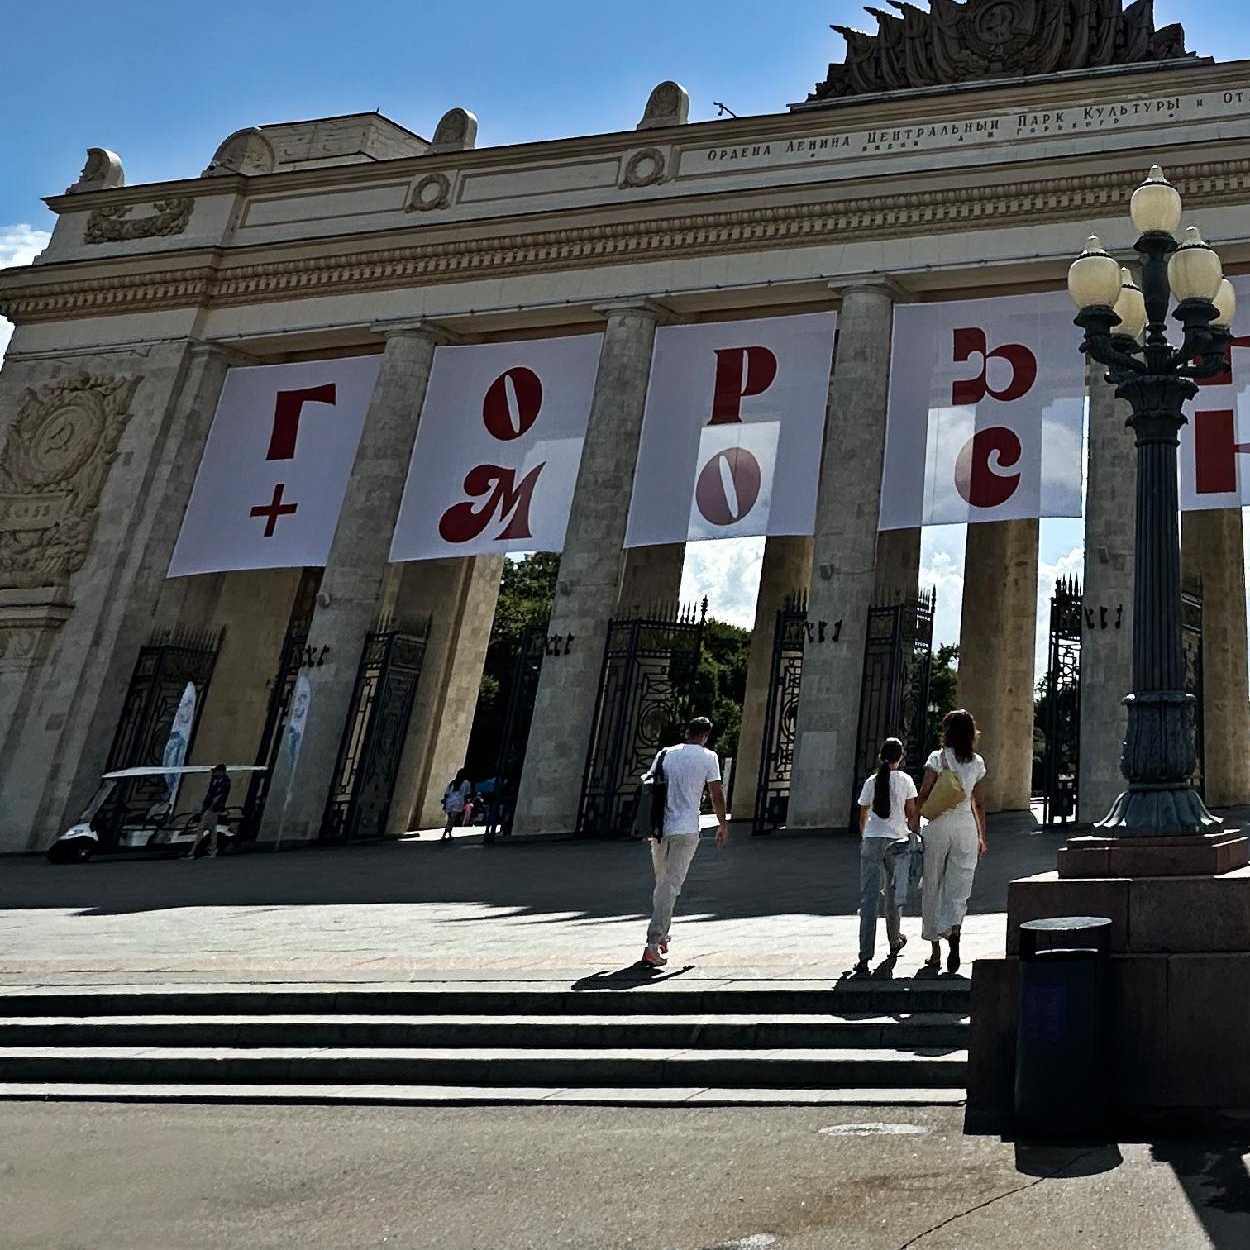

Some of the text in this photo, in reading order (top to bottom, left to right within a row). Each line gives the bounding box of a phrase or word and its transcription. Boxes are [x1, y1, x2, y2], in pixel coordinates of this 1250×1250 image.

[707, 145, 771, 161] ОРДЕНА
[785, 136, 850, 152] ЛЕНИНА
[1018, 112, 1065, 127] ПАРК
[1084, 98, 1180, 120] КУЛЬТУРЫ
